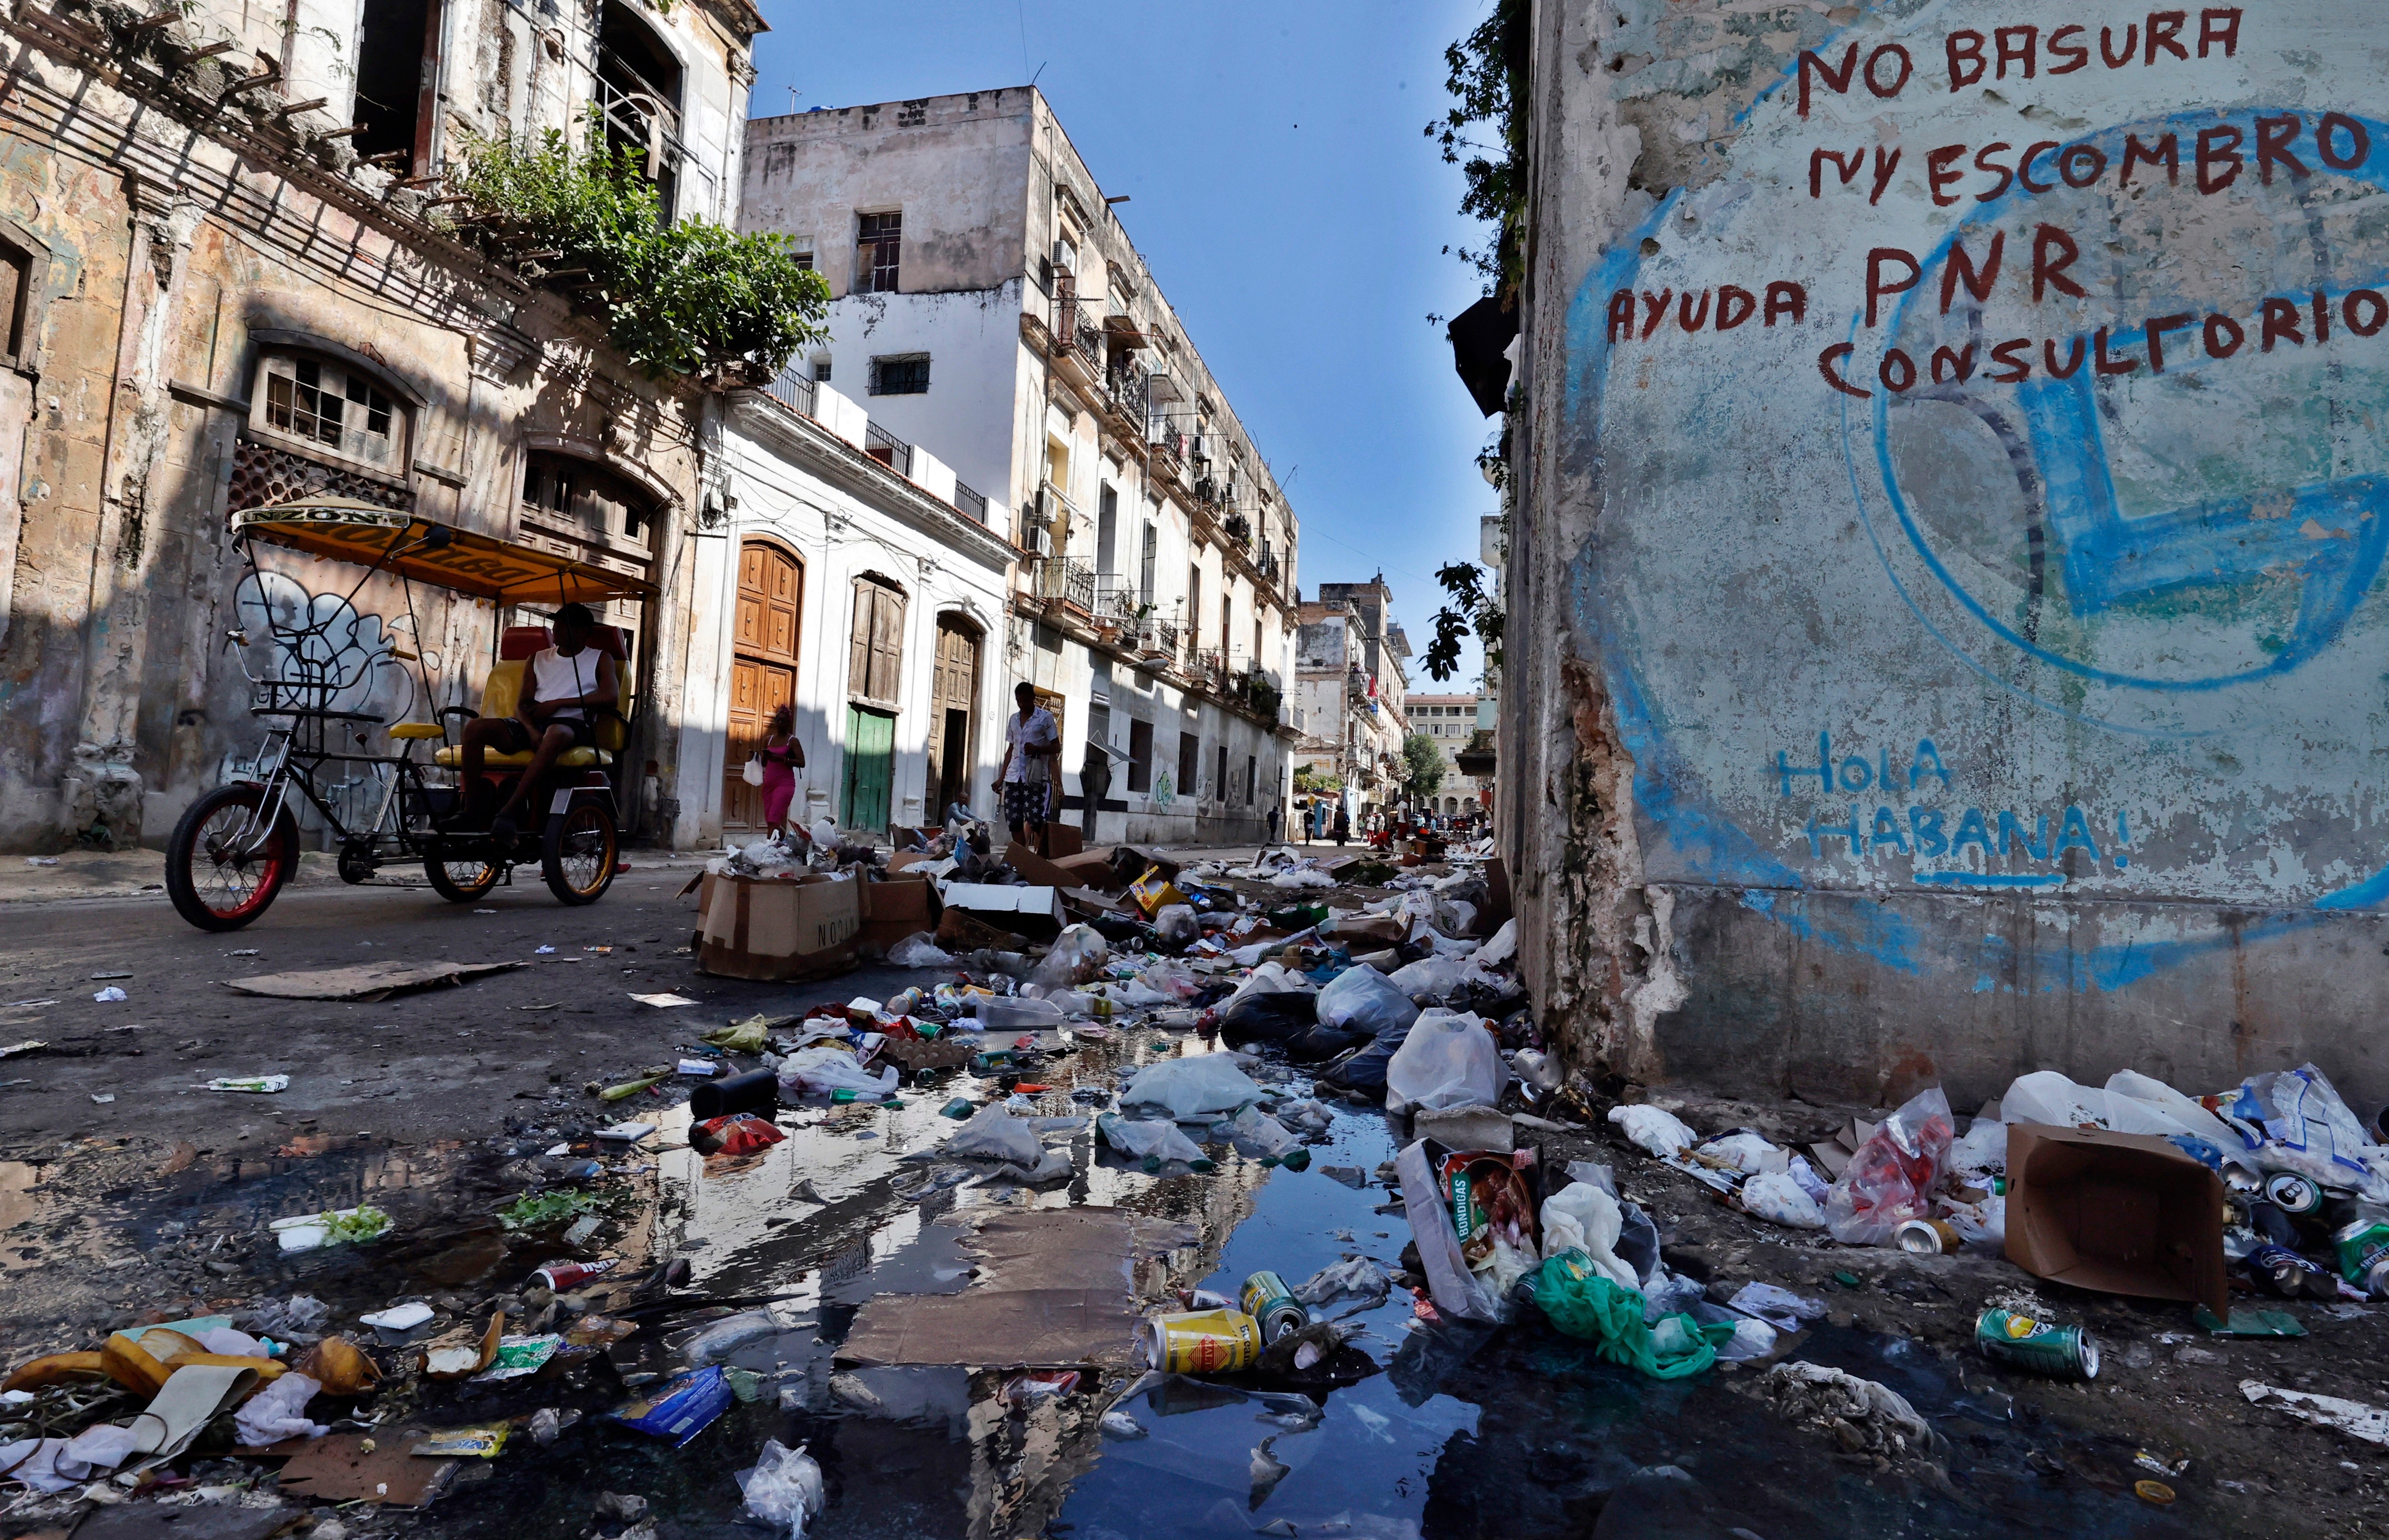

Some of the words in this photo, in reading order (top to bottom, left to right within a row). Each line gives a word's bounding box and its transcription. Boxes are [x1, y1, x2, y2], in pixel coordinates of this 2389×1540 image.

[1796, 41, 1913, 119] NO
[1945, 8, 2243, 92] BASURA
[1809, 146, 1902, 206] NY
[1928, 112, 2372, 207] ESCOMBRO
[1606, 281, 1808, 344] AYUDA
[1865, 222, 2090, 328] PNR
[1816, 288, 2389, 399] CONSULTORIO
[1762, 730, 1953, 798] HOLA
[1204, 1338, 1213, 1371] MALTA
